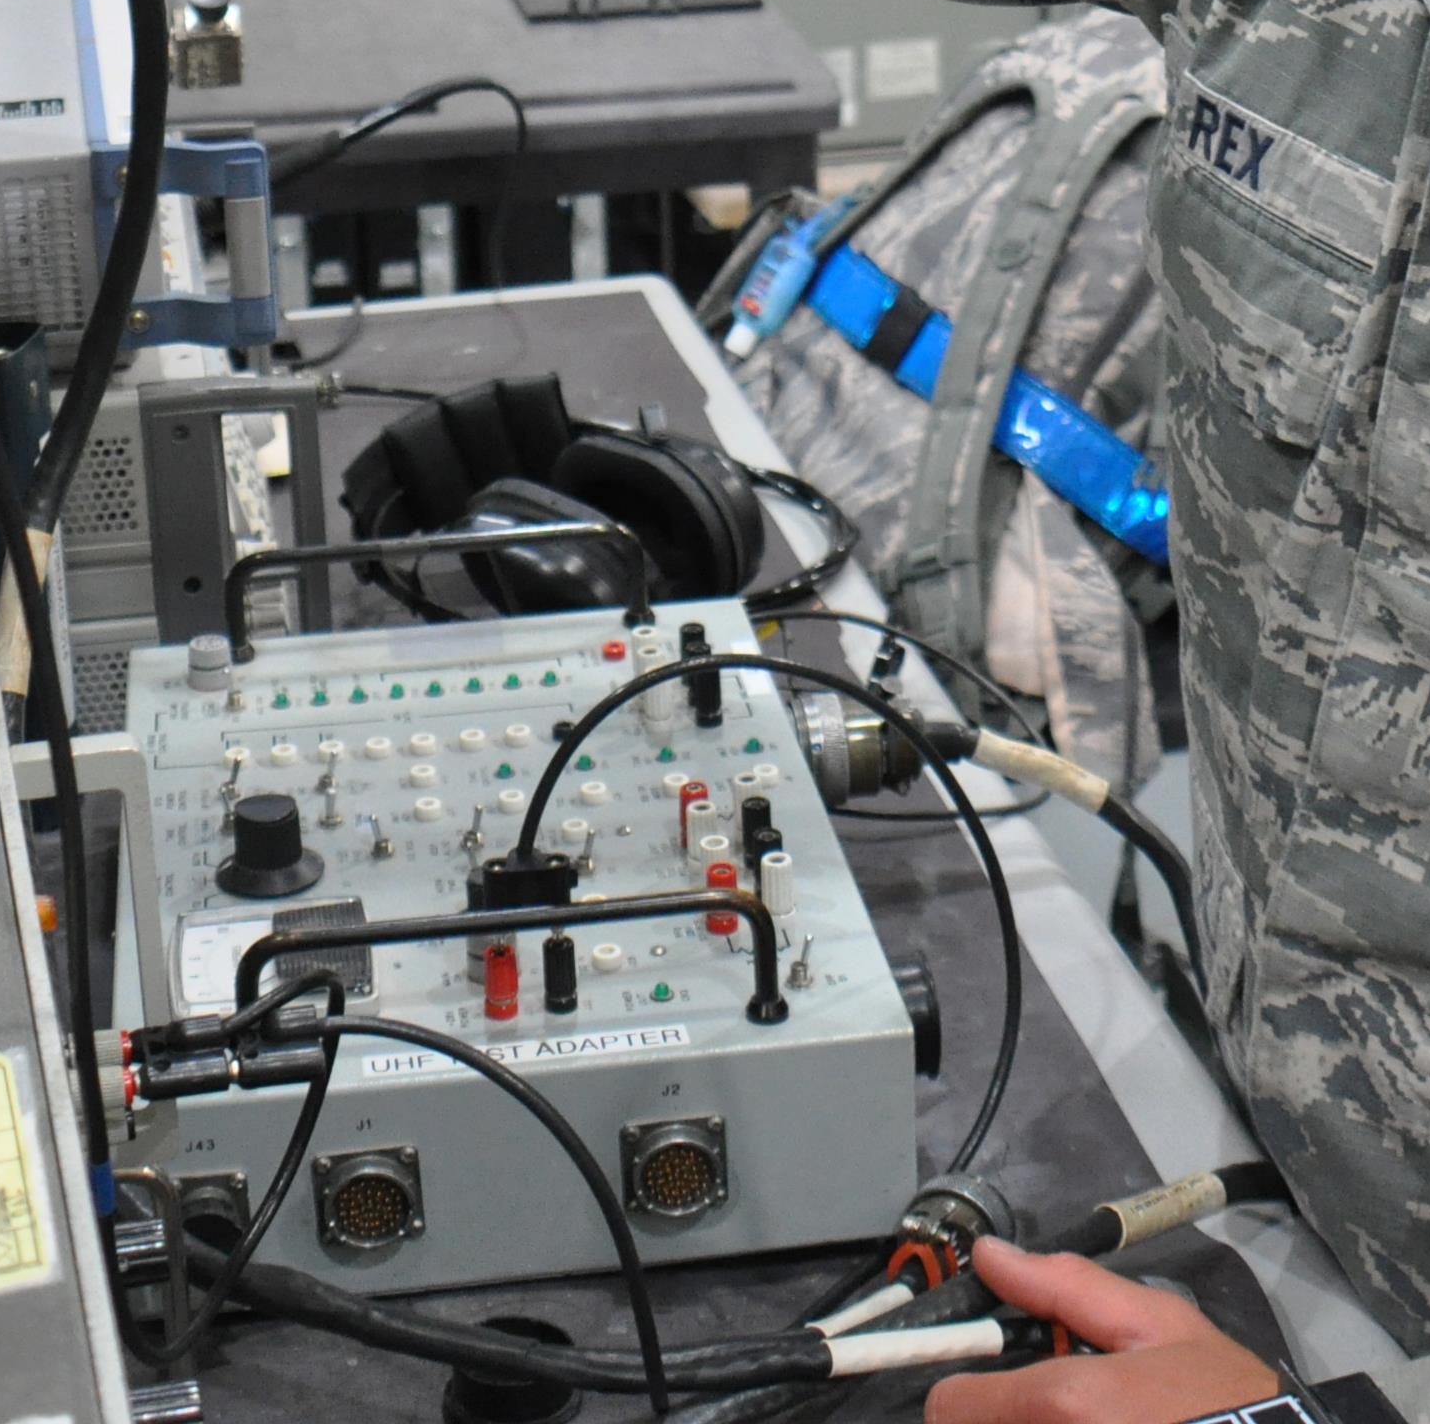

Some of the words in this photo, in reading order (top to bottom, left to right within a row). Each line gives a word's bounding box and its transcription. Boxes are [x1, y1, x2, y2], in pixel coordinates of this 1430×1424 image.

[1188, 94, 1275, 192] REX
[371, 1053, 436, 1074] UHF
[449, 1045, 523, 1066] ST
[535, 1028, 682, 1058] ADAPTER
[661, 1084, 681, 1097] J2
[355, 1117, 372, 1133] J1
[184, 1138, 216, 1154] J43
